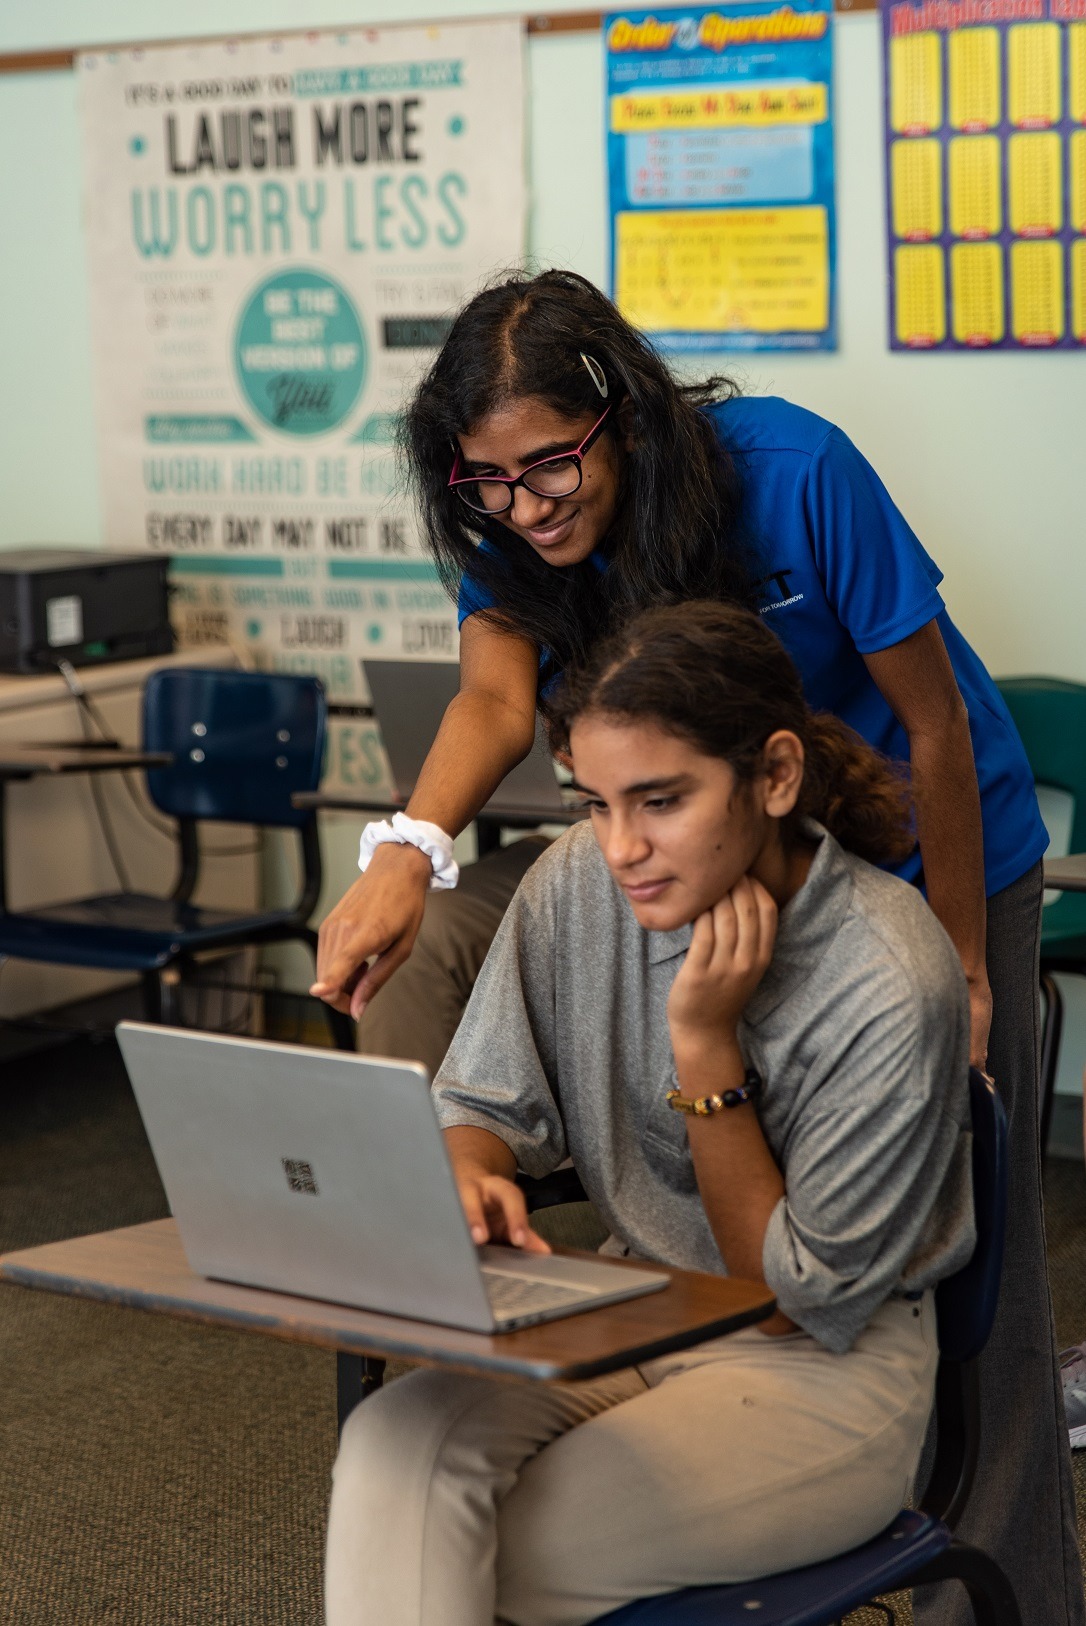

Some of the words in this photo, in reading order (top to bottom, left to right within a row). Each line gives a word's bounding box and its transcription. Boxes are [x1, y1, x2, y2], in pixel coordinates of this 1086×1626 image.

[166, 103, 297, 176] LAUGH
[314, 97, 423, 166] MORE
[131, 178, 327, 260] WORRY
[343, 170, 468, 253] LESS
[147, 514, 211, 549] EVERY
[222, 516, 263, 549] DAY
[271, 517, 314, 549] MAY
[325, 518, 369, 550] NOT
[760, 606, 771, 615] FOR
[771, 593, 804, 609] TOMORROW
